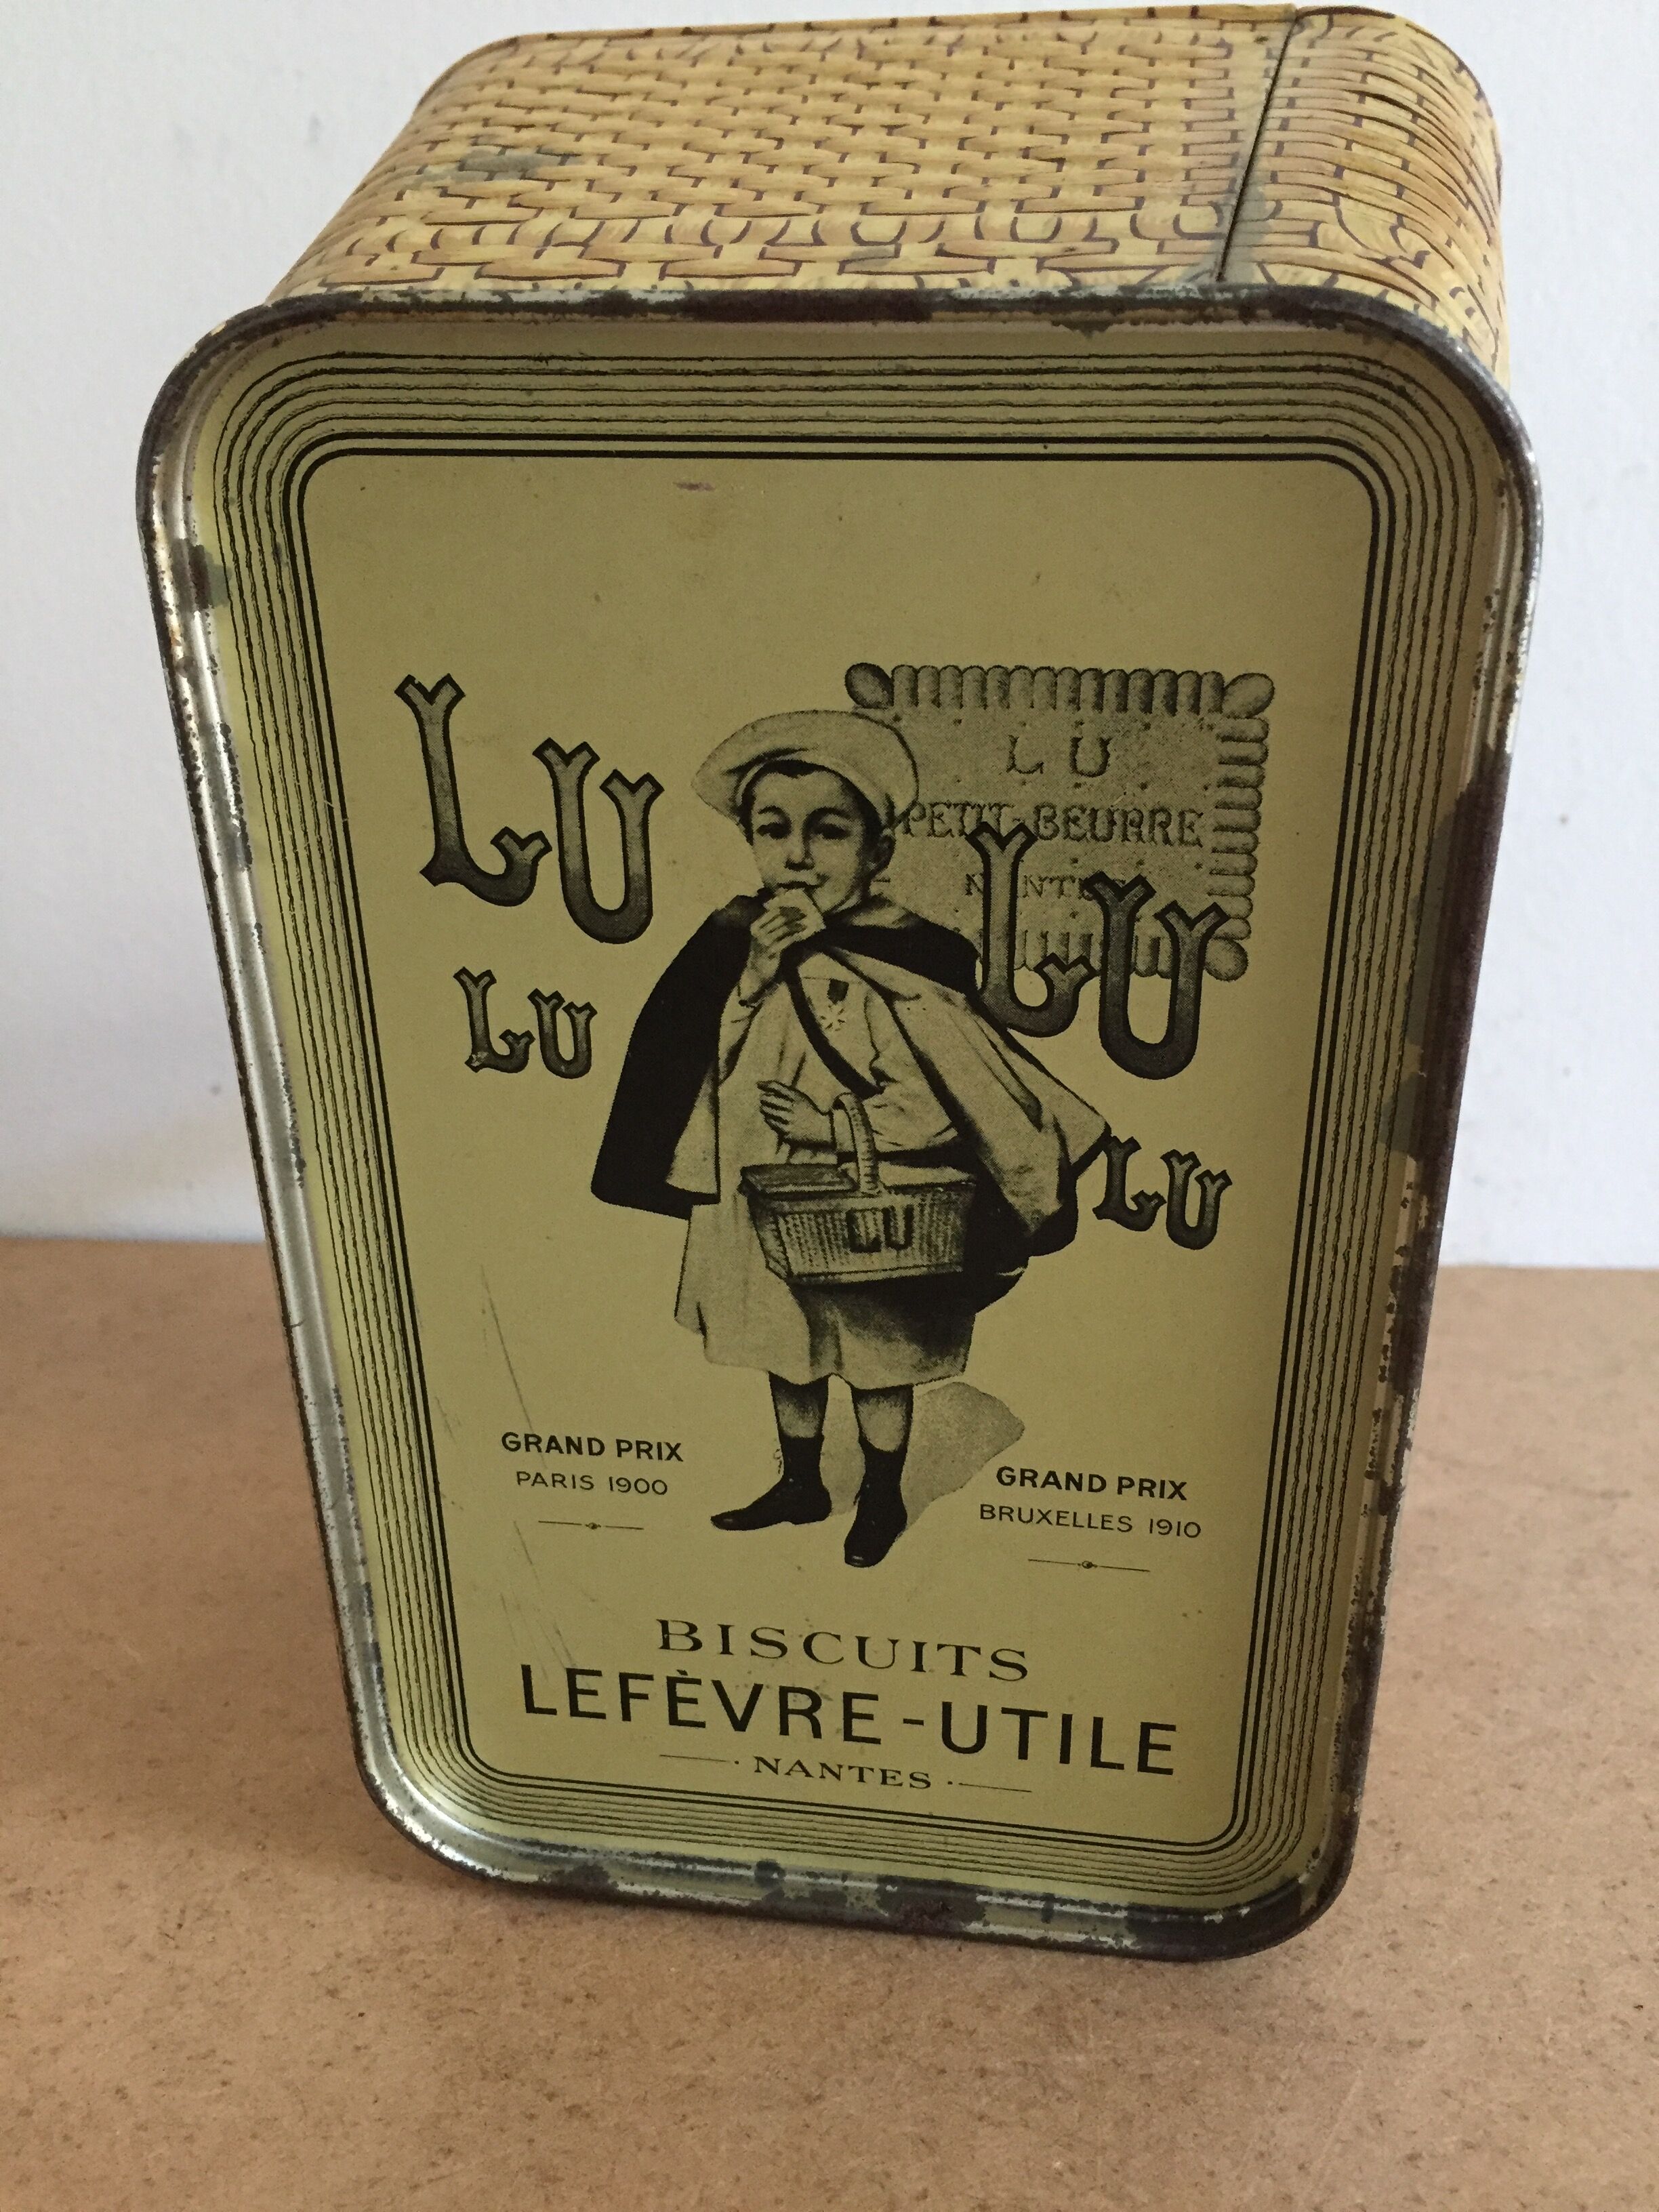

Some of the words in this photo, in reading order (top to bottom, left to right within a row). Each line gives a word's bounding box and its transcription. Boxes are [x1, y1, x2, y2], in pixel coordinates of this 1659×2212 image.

[394, 673, 665, 944] LU
[1033, 802, 1204, 848] BEURRE
[966, 822, 1229, 1080] LU
[453, 966, 598, 1079] LU
[1092, 1134, 1233, 1250] LU
[501, 1432, 605, 1456] GRAND
[616, 1439, 683, 1462] PRIX
[516, 1471, 594, 1490] PARIS
[609, 1477, 668, 1495] 1900
[996, 1466, 1107, 1492] GRAND
[1118, 1476, 1187, 1500] PRIX
[981, 1504, 1132, 1532] BRUXELLES
[1149, 1519, 1201, 1538] 1910
[656, 1619, 1029, 1682] BISCUITS
[754, 1756, 930, 1789] NANTES
